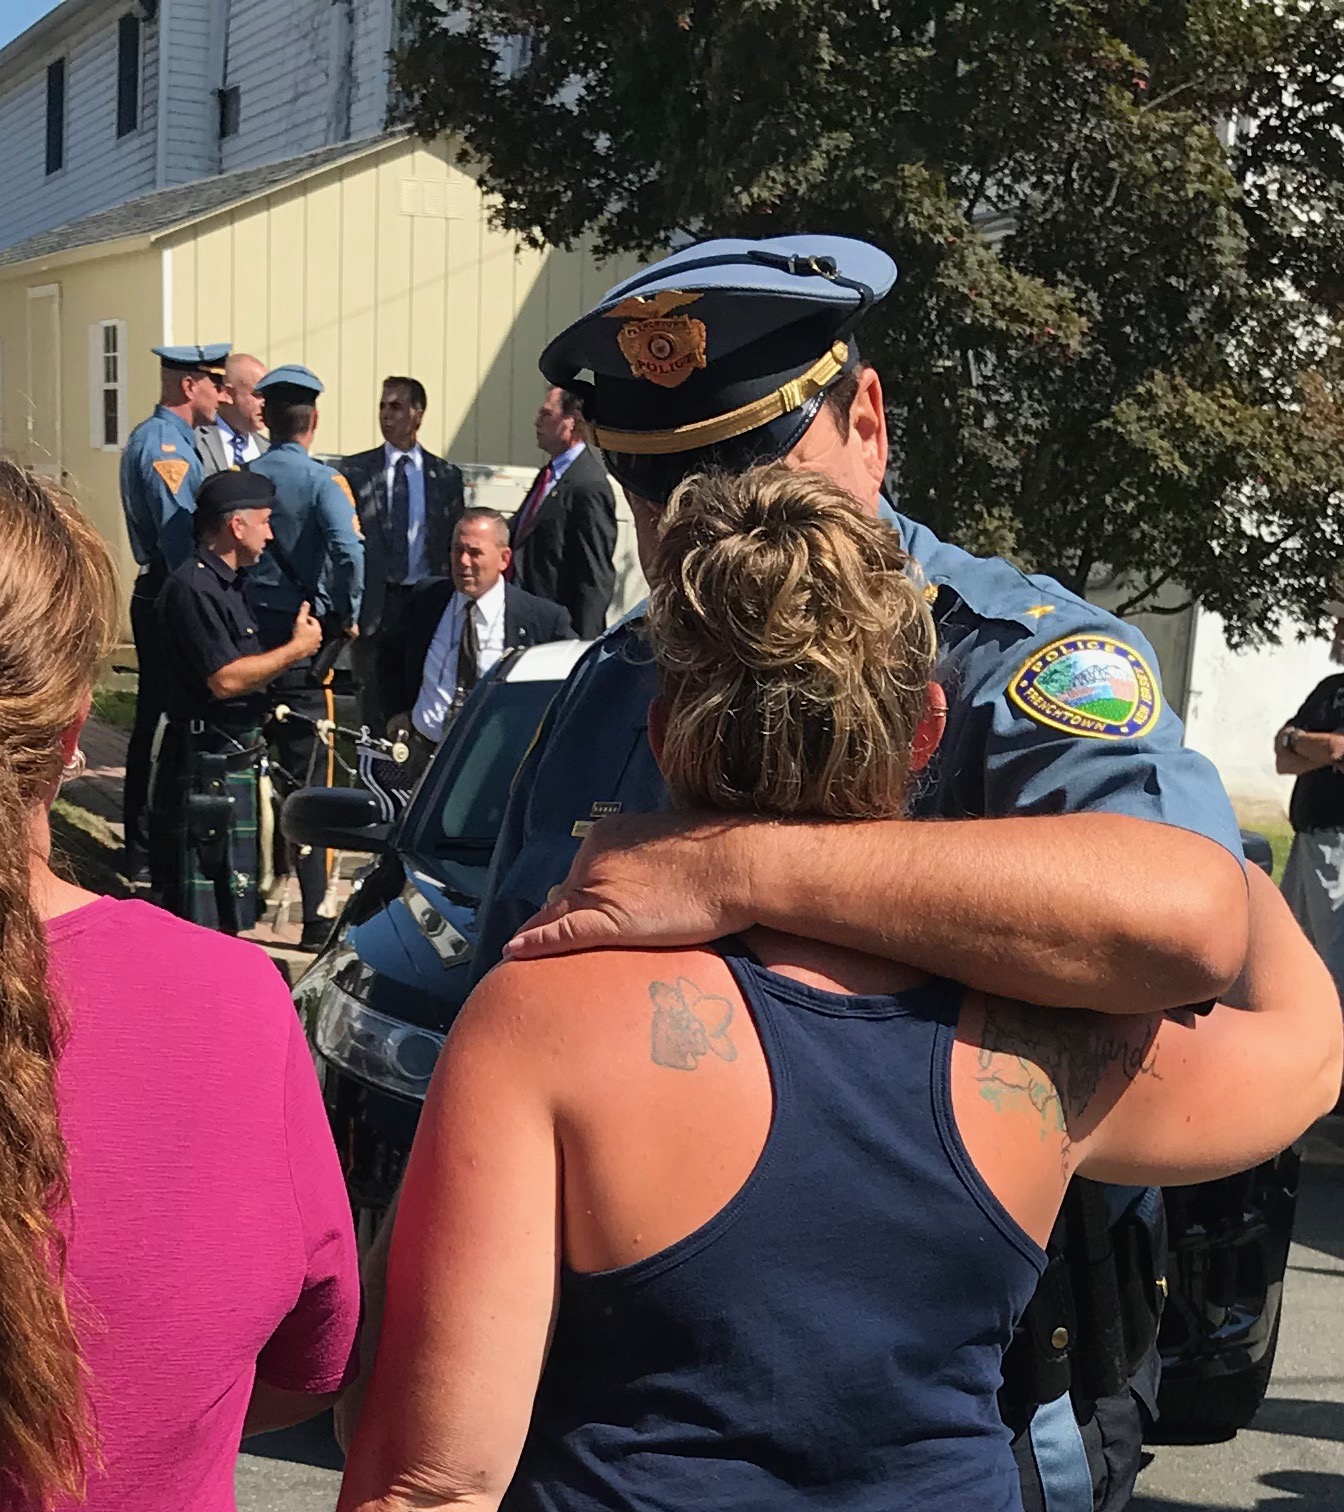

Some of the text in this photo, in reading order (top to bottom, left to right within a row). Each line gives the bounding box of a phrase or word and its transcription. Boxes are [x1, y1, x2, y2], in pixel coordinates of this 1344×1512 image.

[637, 355, 692, 374] POLICE
[1031, 641, 1116, 672] POLICE
[1023, 687, 1106, 731] FRENCHTOWN
